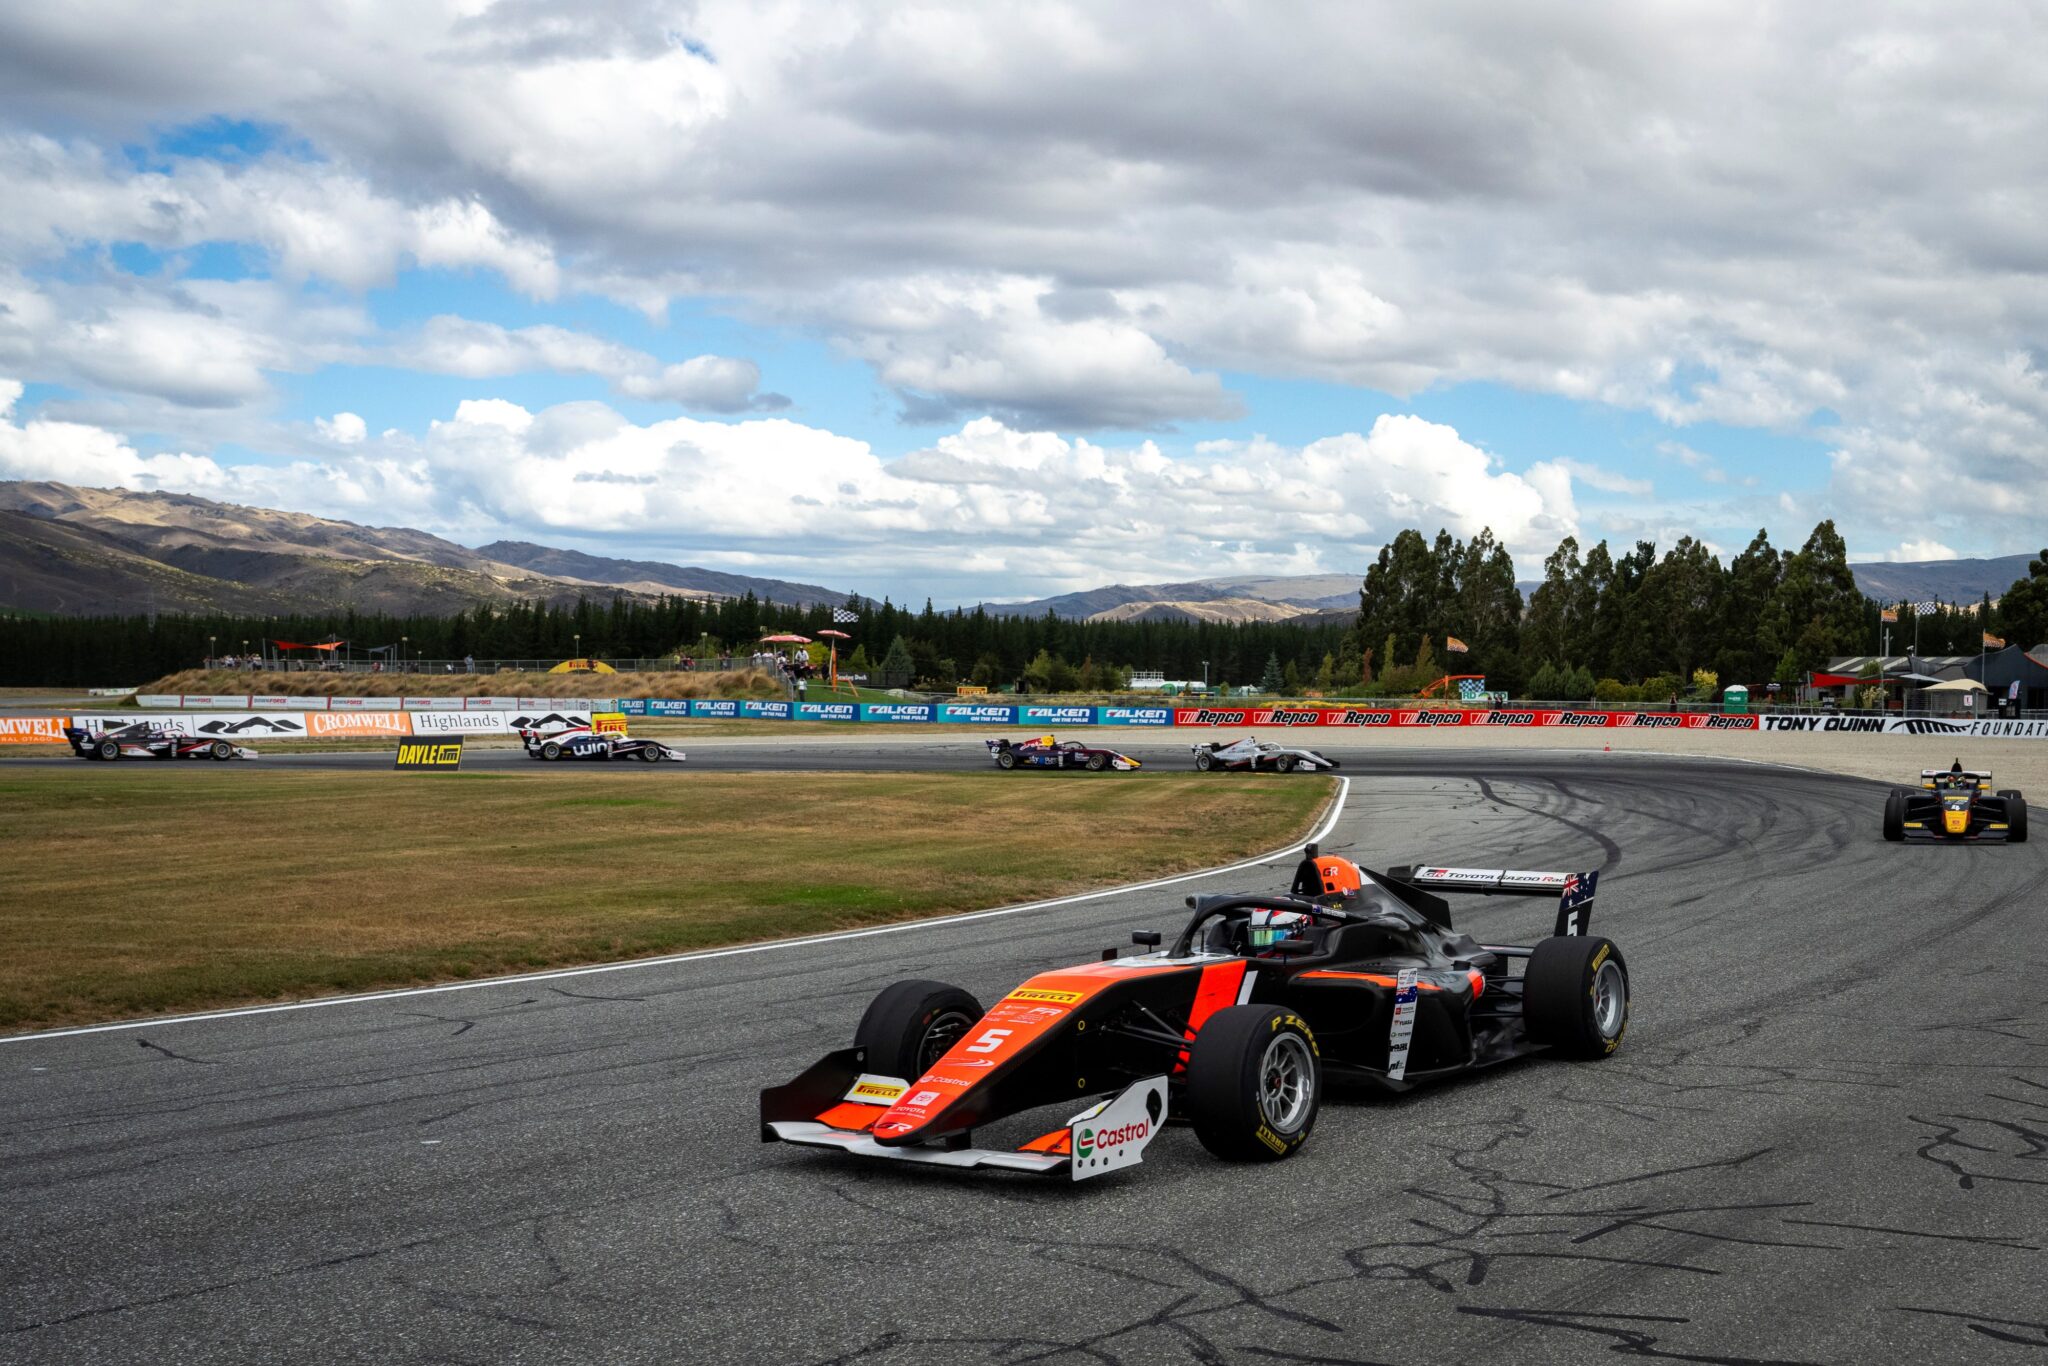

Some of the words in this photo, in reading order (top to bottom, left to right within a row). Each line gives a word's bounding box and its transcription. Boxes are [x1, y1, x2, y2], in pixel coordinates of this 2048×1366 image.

[621, 700, 644, 708] FALKEN
[651, 701, 687, 710] FALKEN
[695, 701, 735, 711] FALKEN
[745, 701, 788, 712] FALKEN
[800, 704, 853, 714] FALKEN
[868, 705, 929, 715] FALKEN
[946, 706, 1010, 716] FALKEN
[1027, 708, 1090, 717] FALKEN
[1106, 709, 1167, 718] FALKEN
[1195, 709, 1244, 726] Repco
[314, 713, 406, 734] CROMWELL
[420, 713, 499, 731] Highlands
[1270, 710, 1319, 726] Repco
[1343, 710, 1392, 726] Repco
[1414, 710, 1463, 726] Repco
[1486, 710, 1534, 726] Repco
[1558, 711, 1608, 727] Repco
[1631, 713, 1682, 728] Repco
[1705, 714, 1755, 729] Repco
[1765, 716, 1822, 731] TONY
[1823, 717, 1886, 732] QUINN
[82, 735, 88, 743] 3
[397, 744, 437, 764] DAYLE
[1323, 866, 1338, 877] GR
[1448, 872, 1494, 880] TOYOTA
[1014, 990, 1076, 1001] PIRELLI
[966, 1028, 1014, 1053] 5
[1271, 1016, 1282, 1031] P
[1285, 1015, 1320, 1057] ZERO
[932, 1076, 972, 1087] Castrol
[856, 1085, 900, 1097] PIRELLI
[895, 1106, 926, 1114] TOYOTA
[1096, 1117, 1149, 1149] Castrol
[1255, 1124, 1288, 1155] PIRELLI
